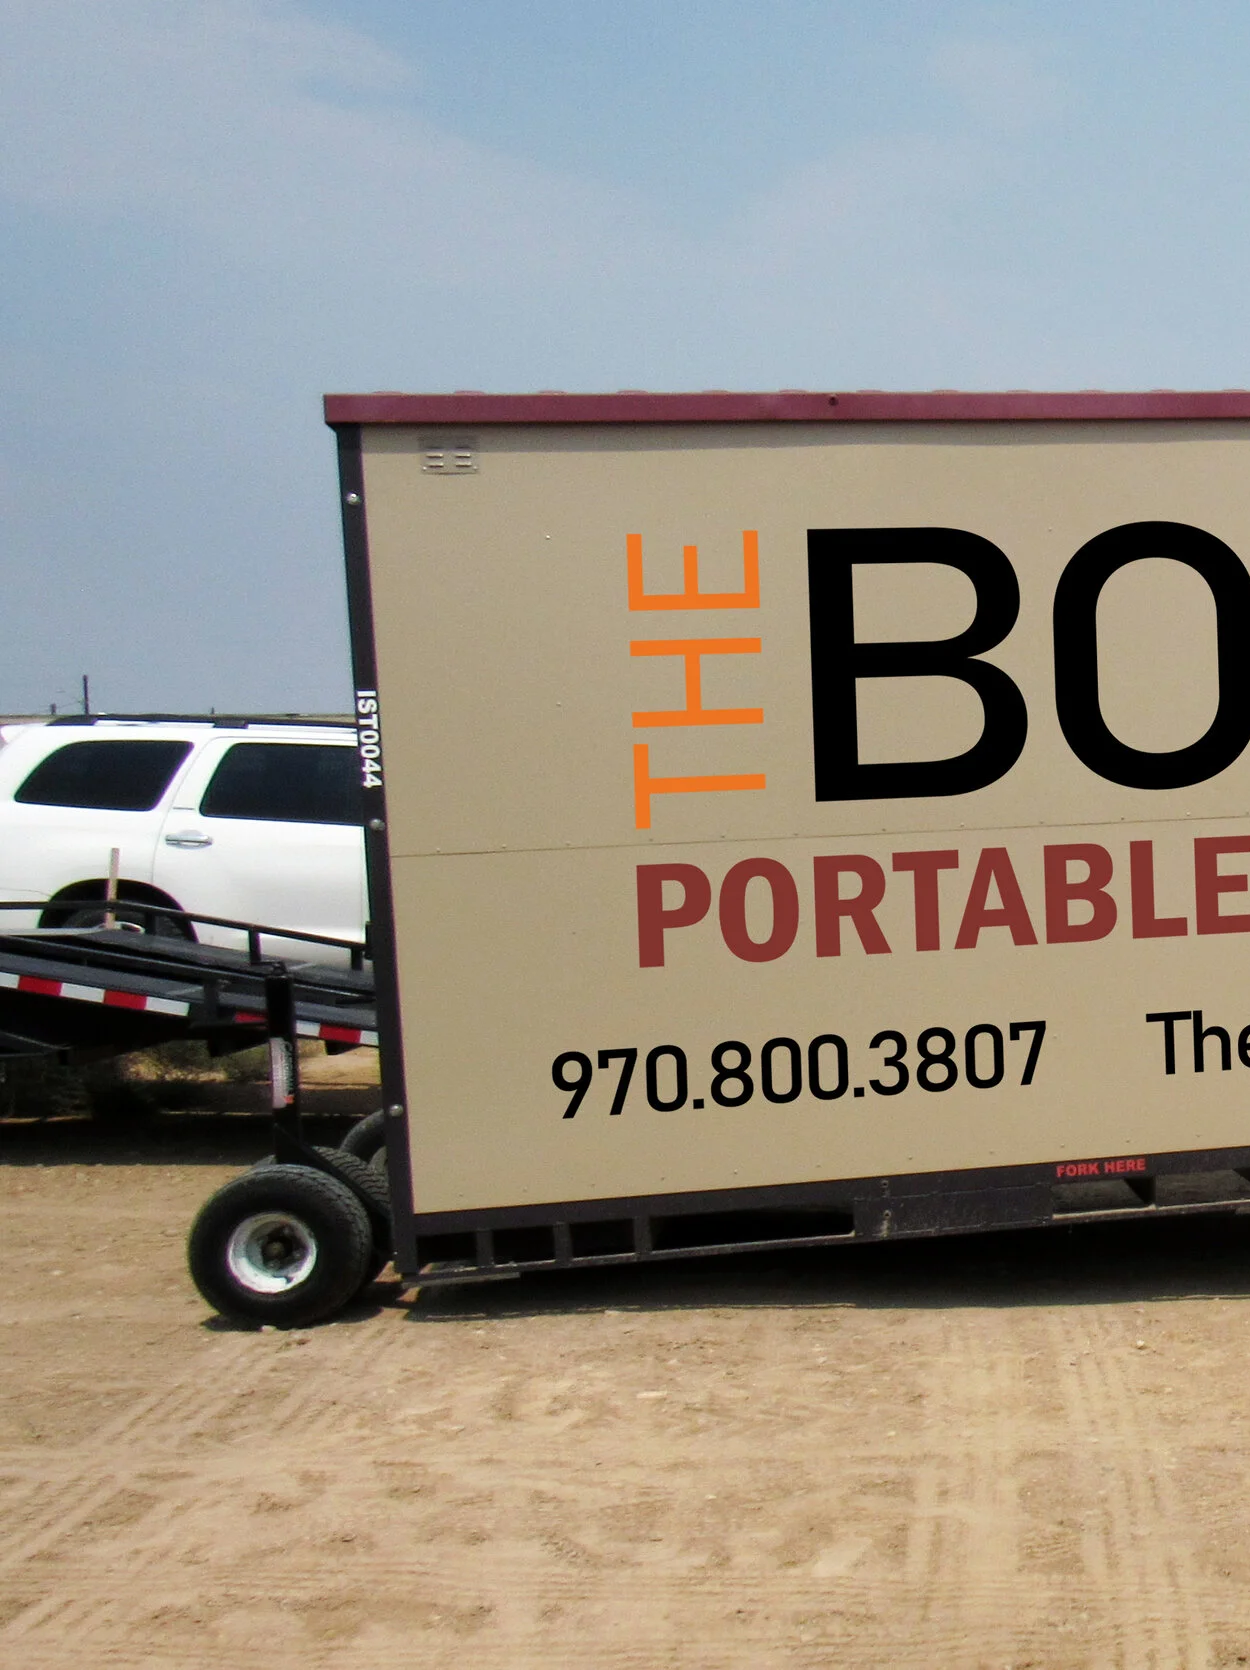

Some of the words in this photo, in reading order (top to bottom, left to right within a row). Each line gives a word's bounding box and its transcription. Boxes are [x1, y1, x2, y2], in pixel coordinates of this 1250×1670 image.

[626, 530, 766, 829] THE
[357, 690, 383, 788] IST0044
[552, 1021, 1046, 1119] 970.800.3807
[1056, 1163, 1099, 1177] FORK
[1104, 1159, 1146, 1173] HERE
